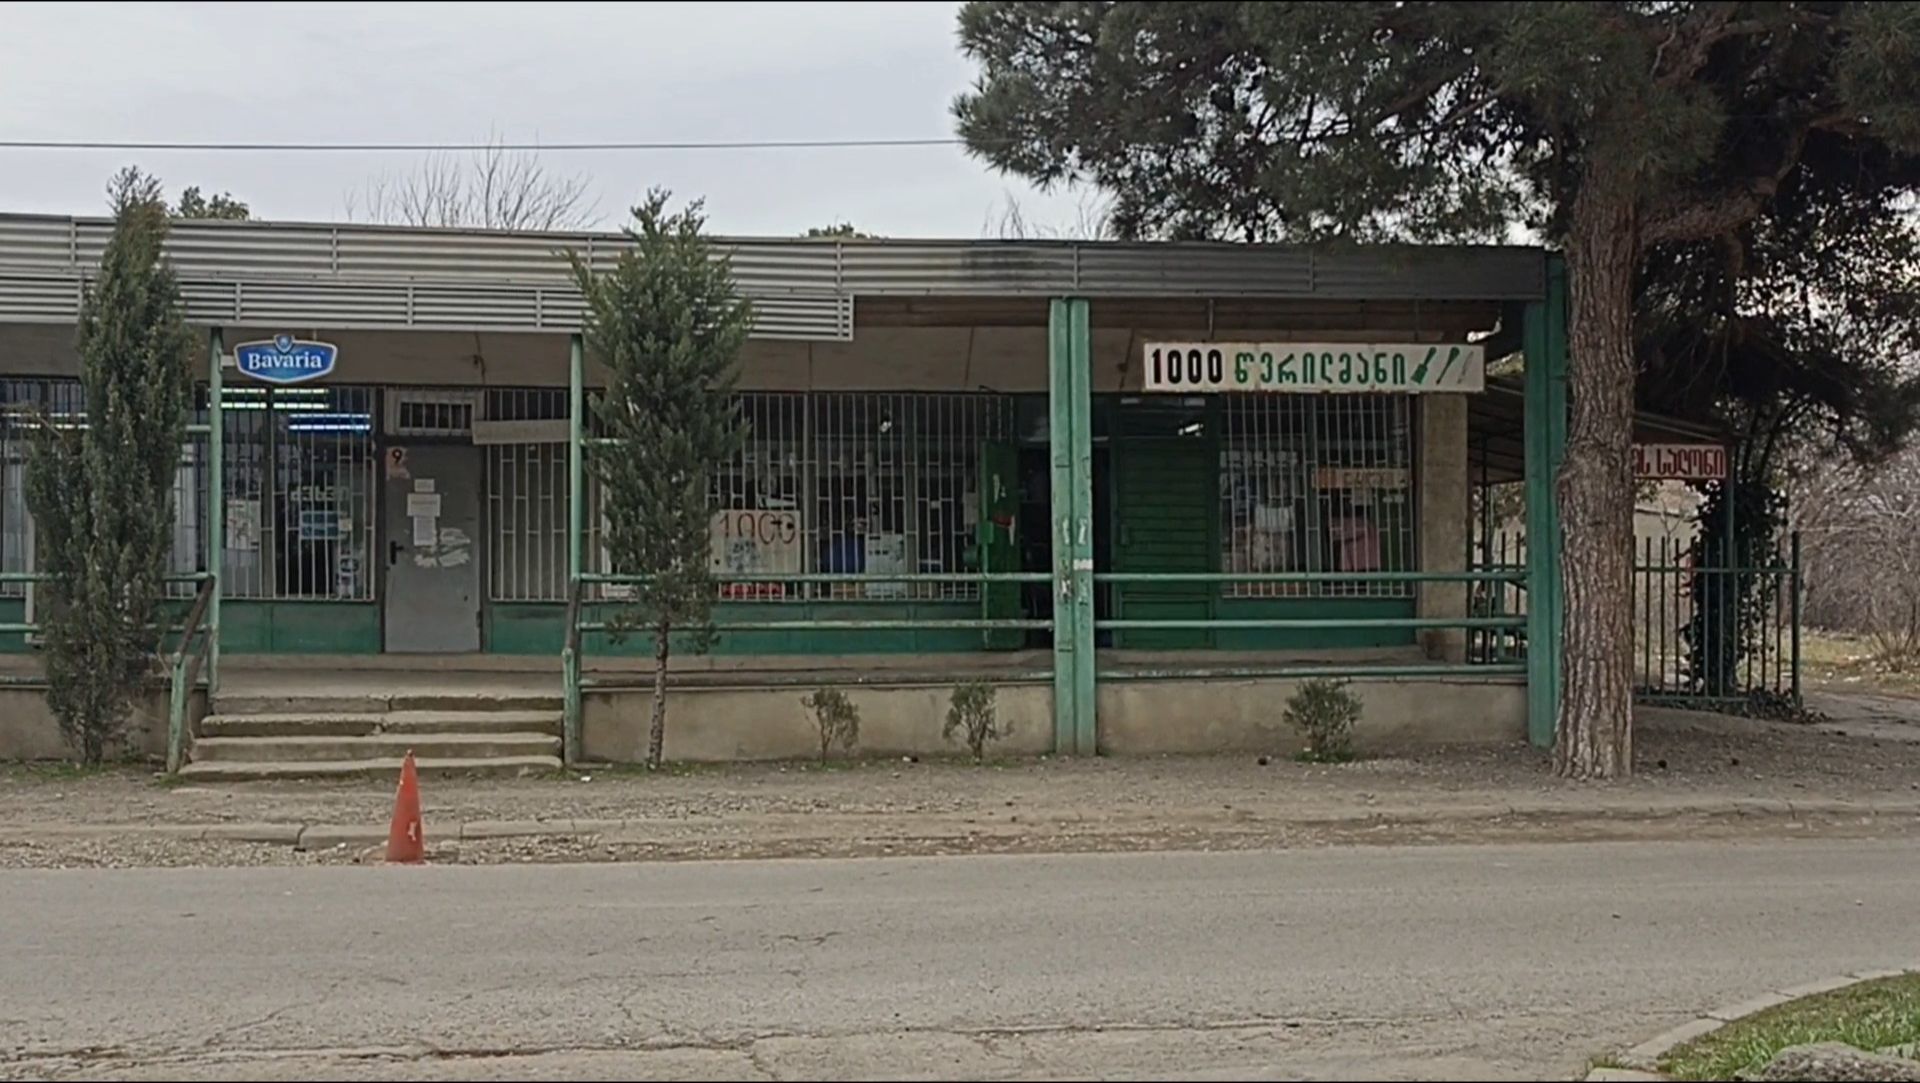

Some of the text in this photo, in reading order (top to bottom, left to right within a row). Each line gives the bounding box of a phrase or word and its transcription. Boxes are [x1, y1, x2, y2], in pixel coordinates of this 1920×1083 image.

[247, 351, 322, 370] Bavaria
[1152, 349, 1406, 385] 1000 წვრილმანი
[1656, 448, 1724, 475] სალონი
